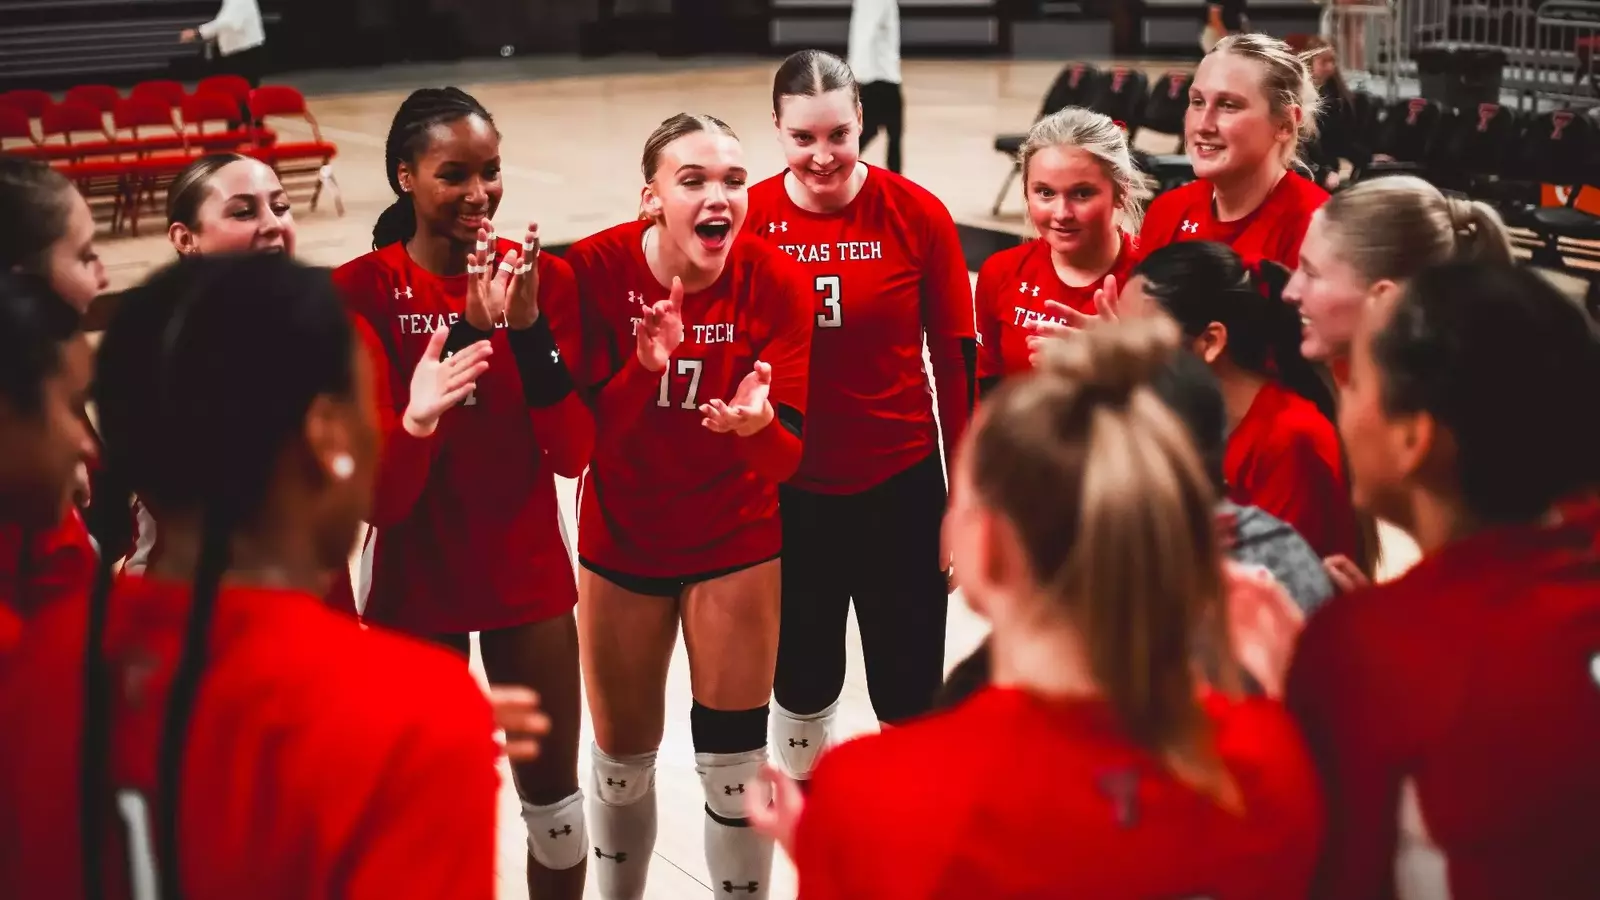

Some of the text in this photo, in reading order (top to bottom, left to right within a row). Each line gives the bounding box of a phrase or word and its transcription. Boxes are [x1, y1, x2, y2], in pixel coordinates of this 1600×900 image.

[777, 240, 883, 263] EXAS TECH
[815, 275, 842, 328] 3
[692, 322, 735, 344] TECH
[656, 358, 703, 410] 17
